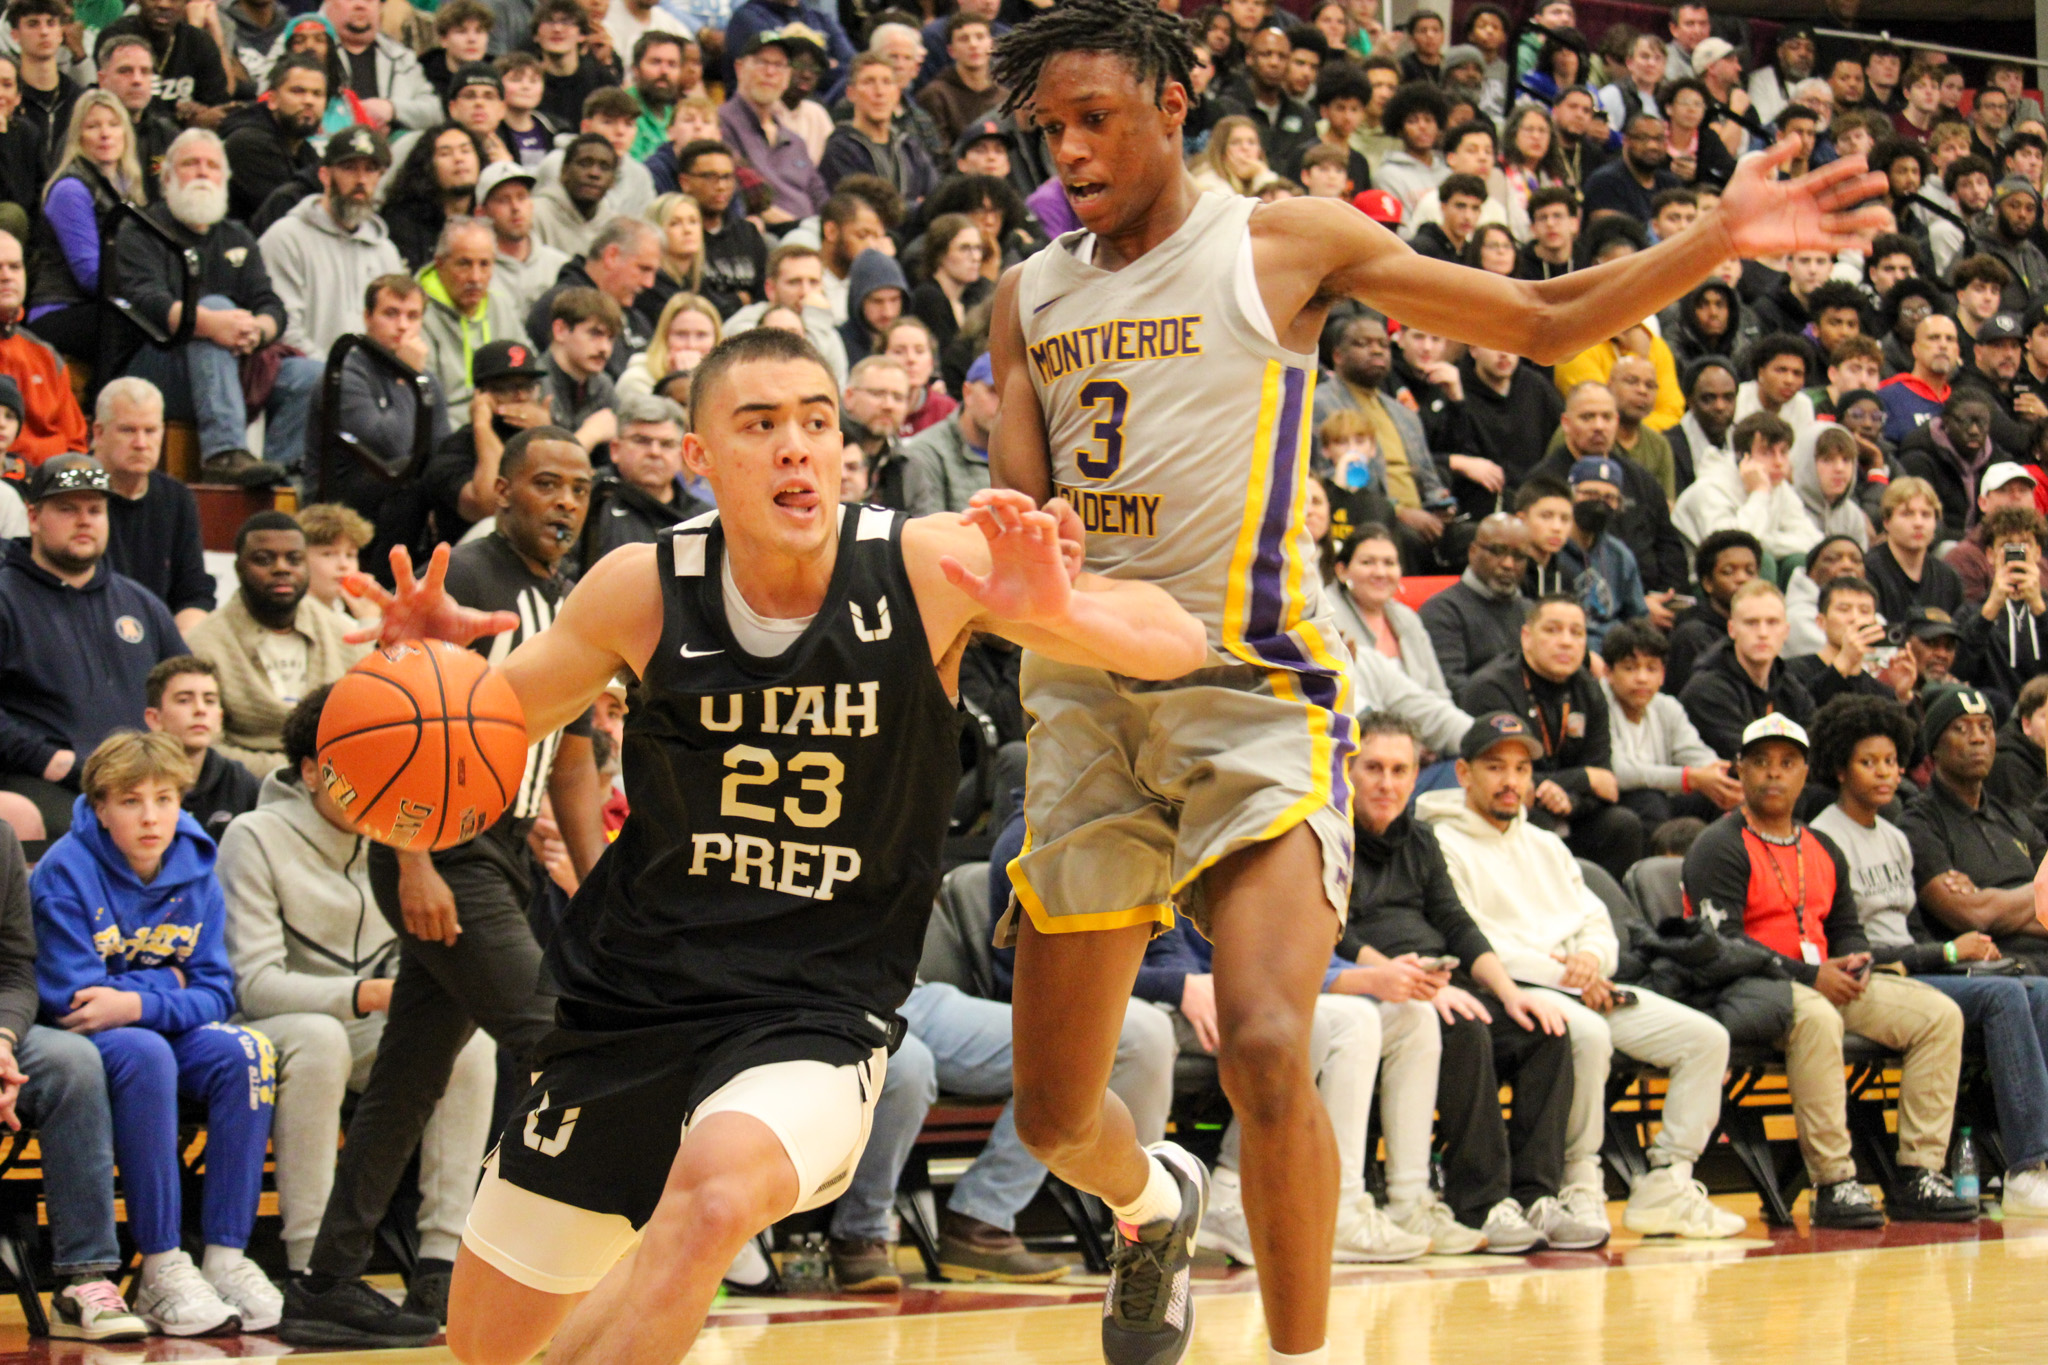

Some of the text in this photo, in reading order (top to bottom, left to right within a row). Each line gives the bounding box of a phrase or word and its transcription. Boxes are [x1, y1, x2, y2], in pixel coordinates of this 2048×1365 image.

[1028, 314, 1203, 386] MONTVERDE
[1075, 378, 1130, 481] 3
[1057, 485, 1164, 538] ADEMY
[700, 680, 880, 738] UTAH
[720, 743, 845, 828] 23
[687, 832, 862, 901] PREP
